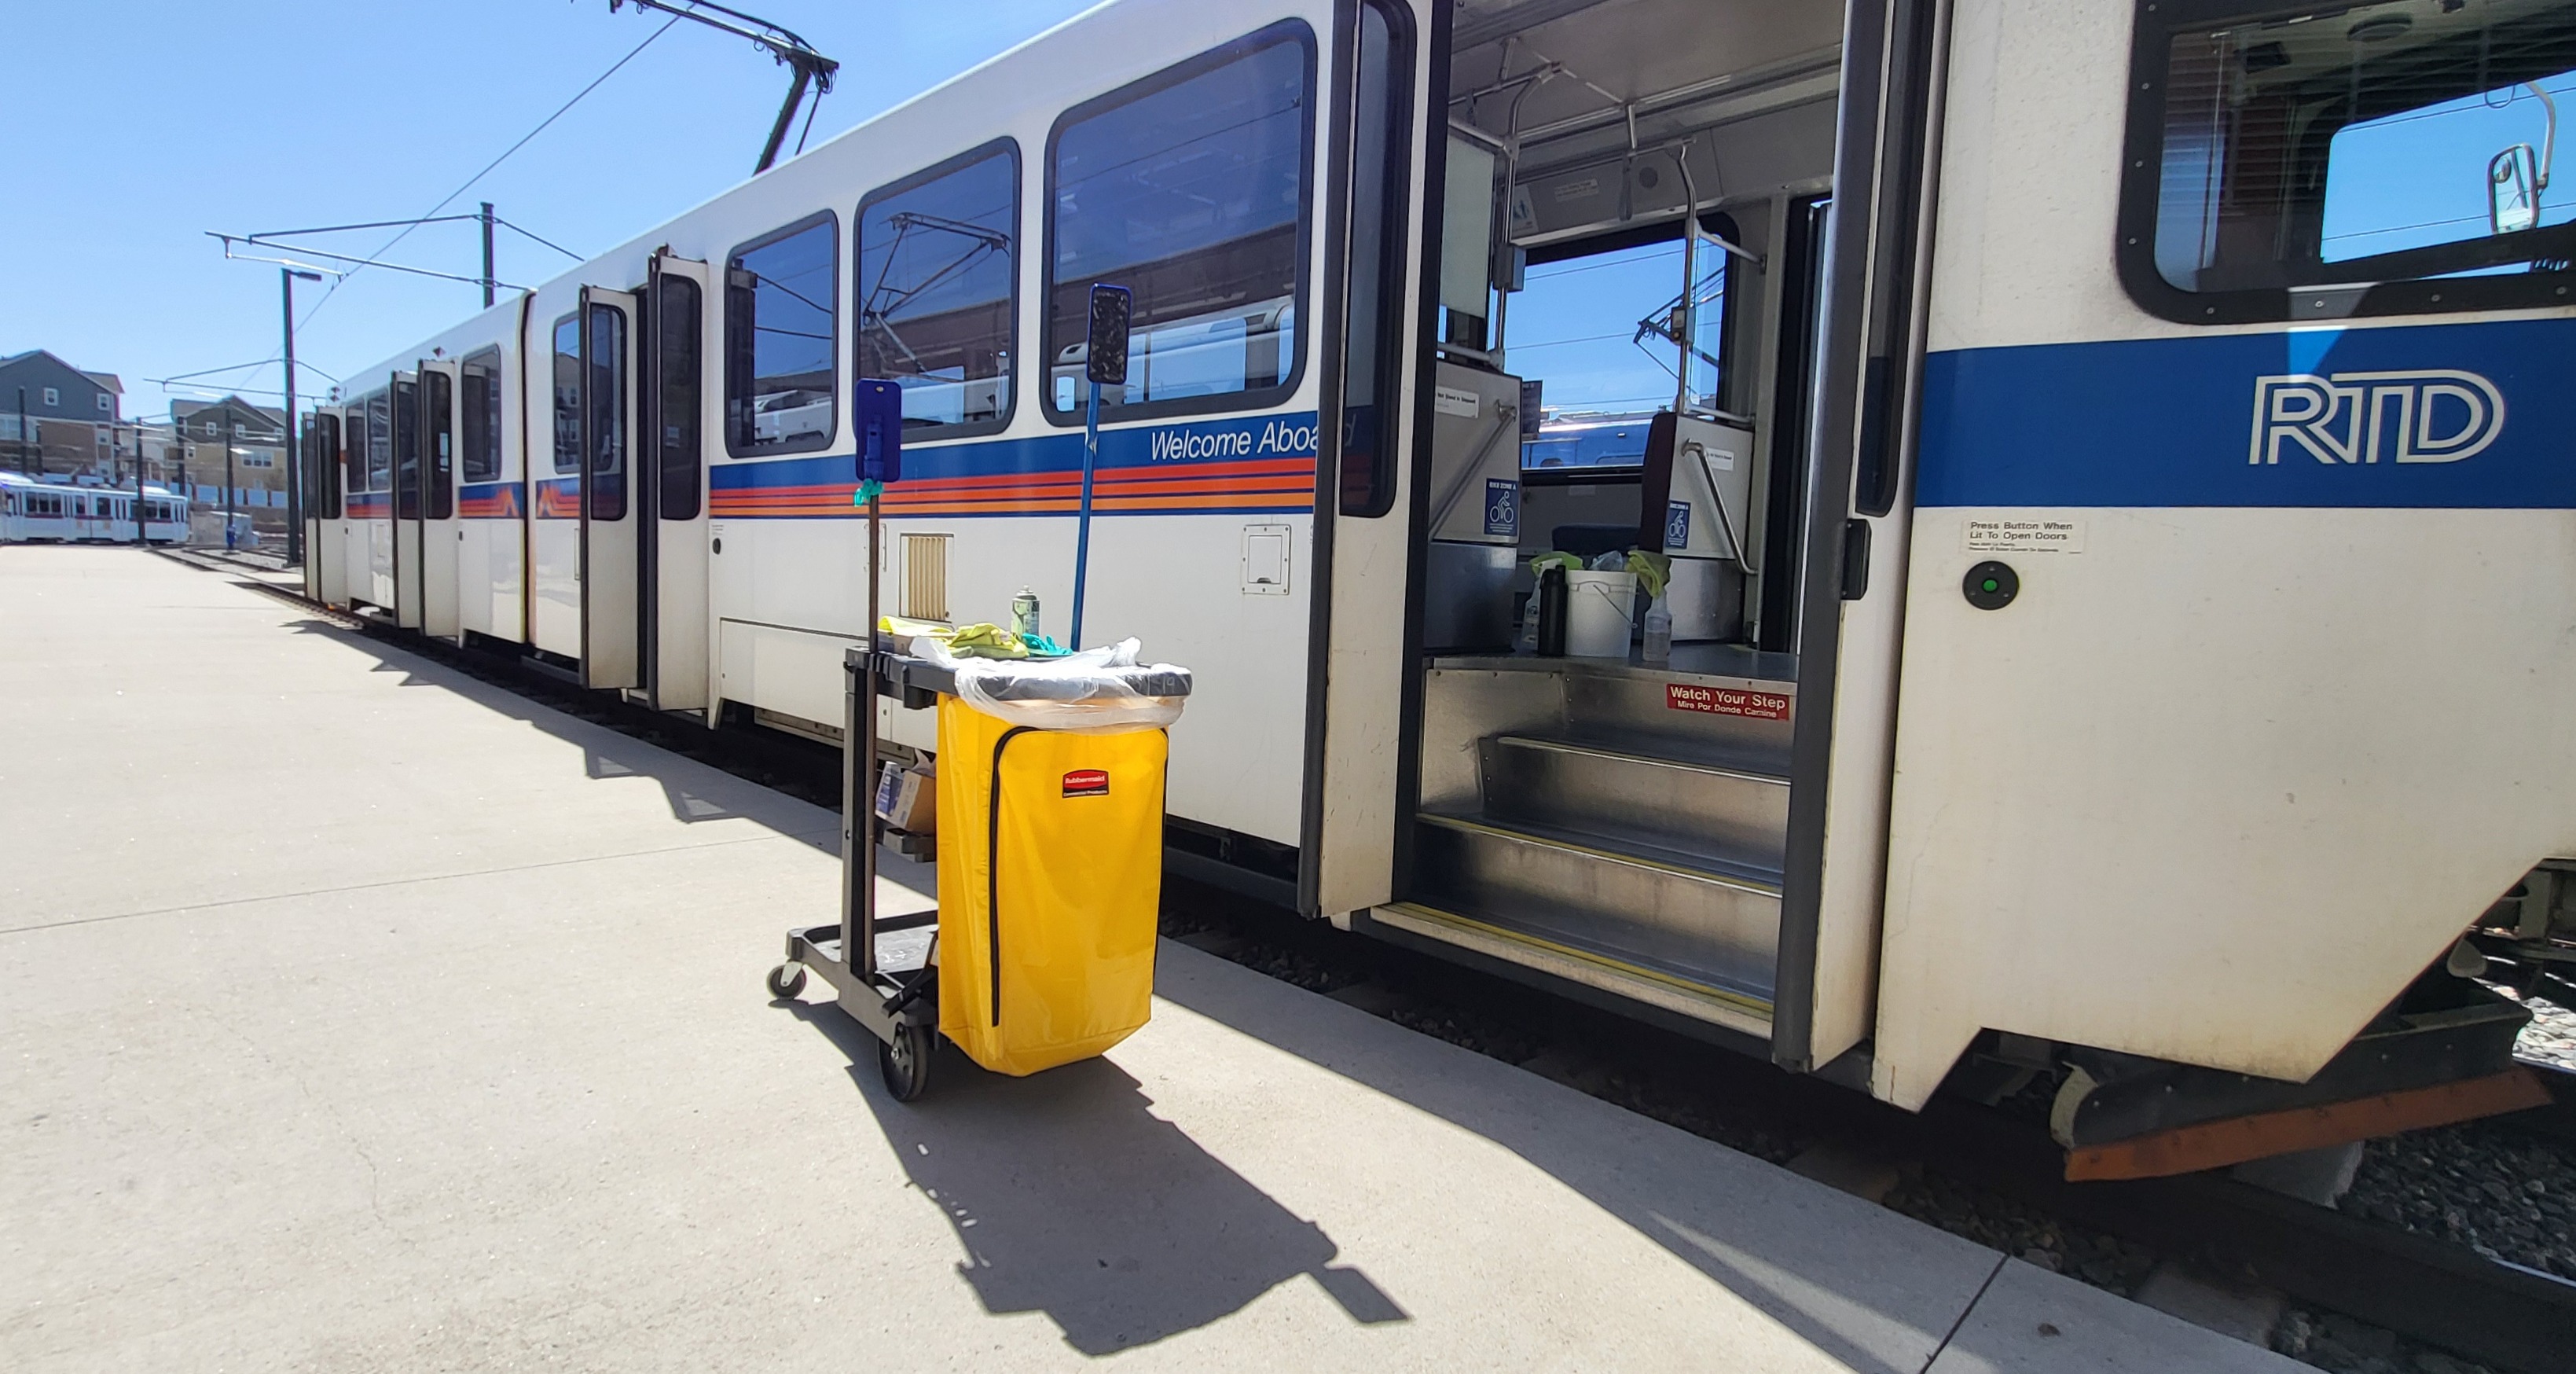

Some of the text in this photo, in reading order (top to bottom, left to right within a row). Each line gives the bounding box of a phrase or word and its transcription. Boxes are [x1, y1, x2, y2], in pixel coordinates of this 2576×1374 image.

[2248, 369, 2504, 465] RTD
[1151, 429, 1252, 461] Welcome
[1970, 521, 1999, 530] Press
[2004, 521, 2038, 530] Button
[2003, 531, 2031, 541] Open
[1670, 686, 1785, 710] Watch Your Step
[1677, 700, 1695, 709] Mire
[1714, 704, 1741, 714] Donde
[1745, 707, 1777, 718] Camine
